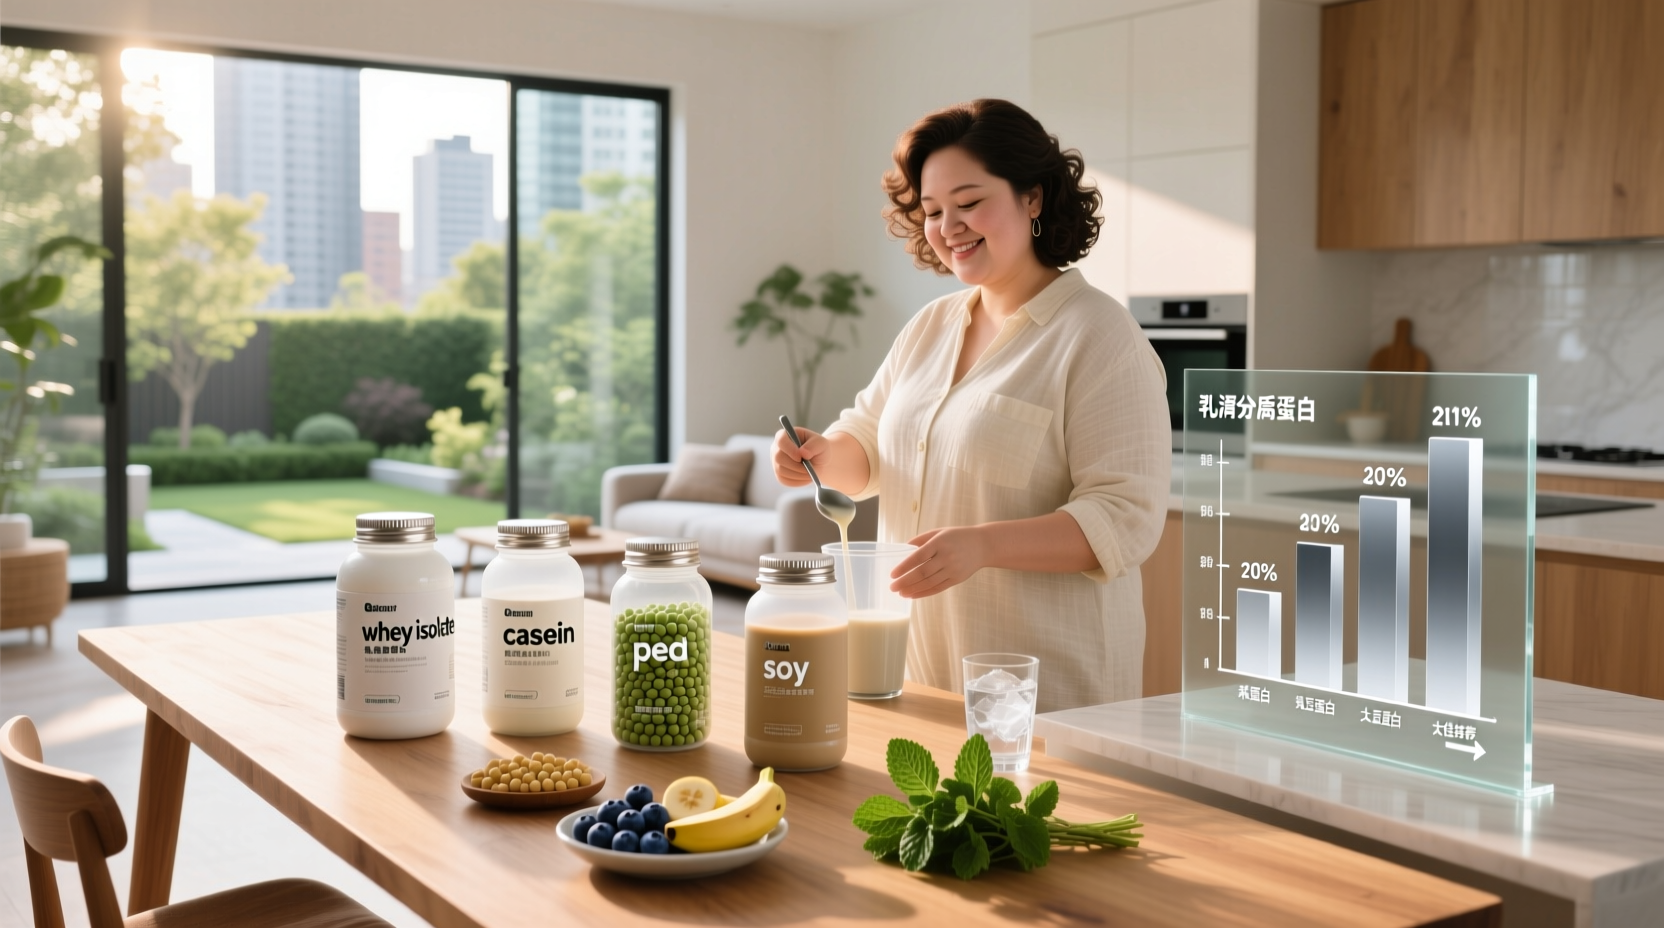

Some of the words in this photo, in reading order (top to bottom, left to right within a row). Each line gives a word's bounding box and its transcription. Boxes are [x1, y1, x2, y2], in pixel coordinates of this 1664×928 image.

[1362, 466, 1407, 487] 20%
[1299, 513, 1340, 534] 20%
[1241, 562, 1278, 582] 20%
[361, 620, 413, 647] whey
[503, 621, 575, 646] casein
[633, 636, 688, 672] ped
[763, 659, 810, 688] soy
